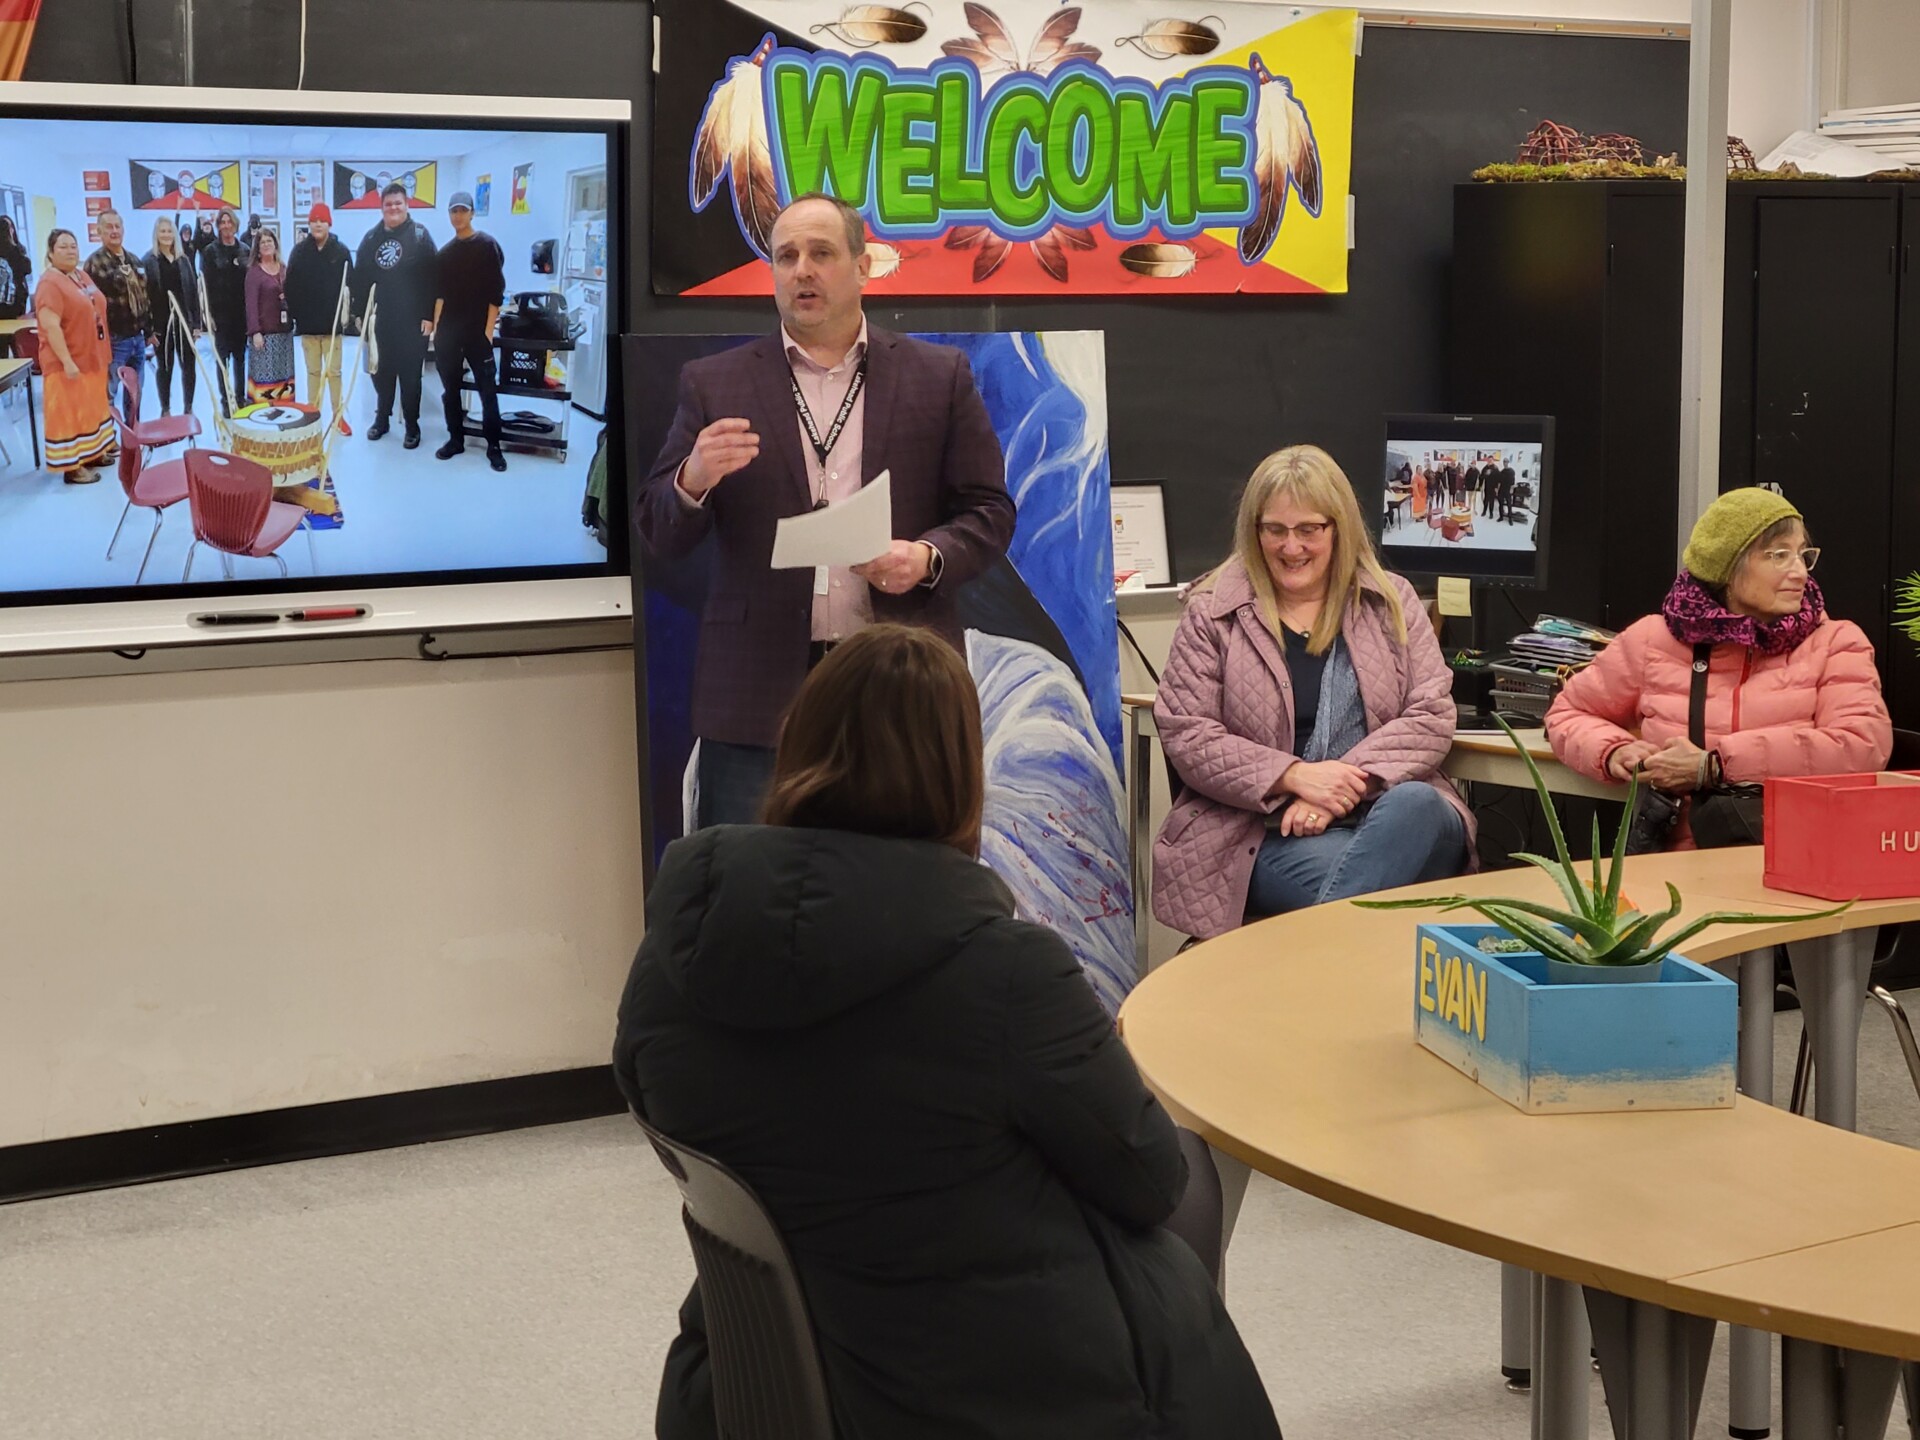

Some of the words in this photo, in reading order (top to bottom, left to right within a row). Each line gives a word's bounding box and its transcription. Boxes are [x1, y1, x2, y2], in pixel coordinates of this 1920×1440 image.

[776, 66, 1251, 226] WELCOME
[846, 372, 864, 402] Lakehead
[837, 402, 851, 424] Public
[824, 423, 841, 451] Schools
[1420, 936, 1487, 1041] EVAN
